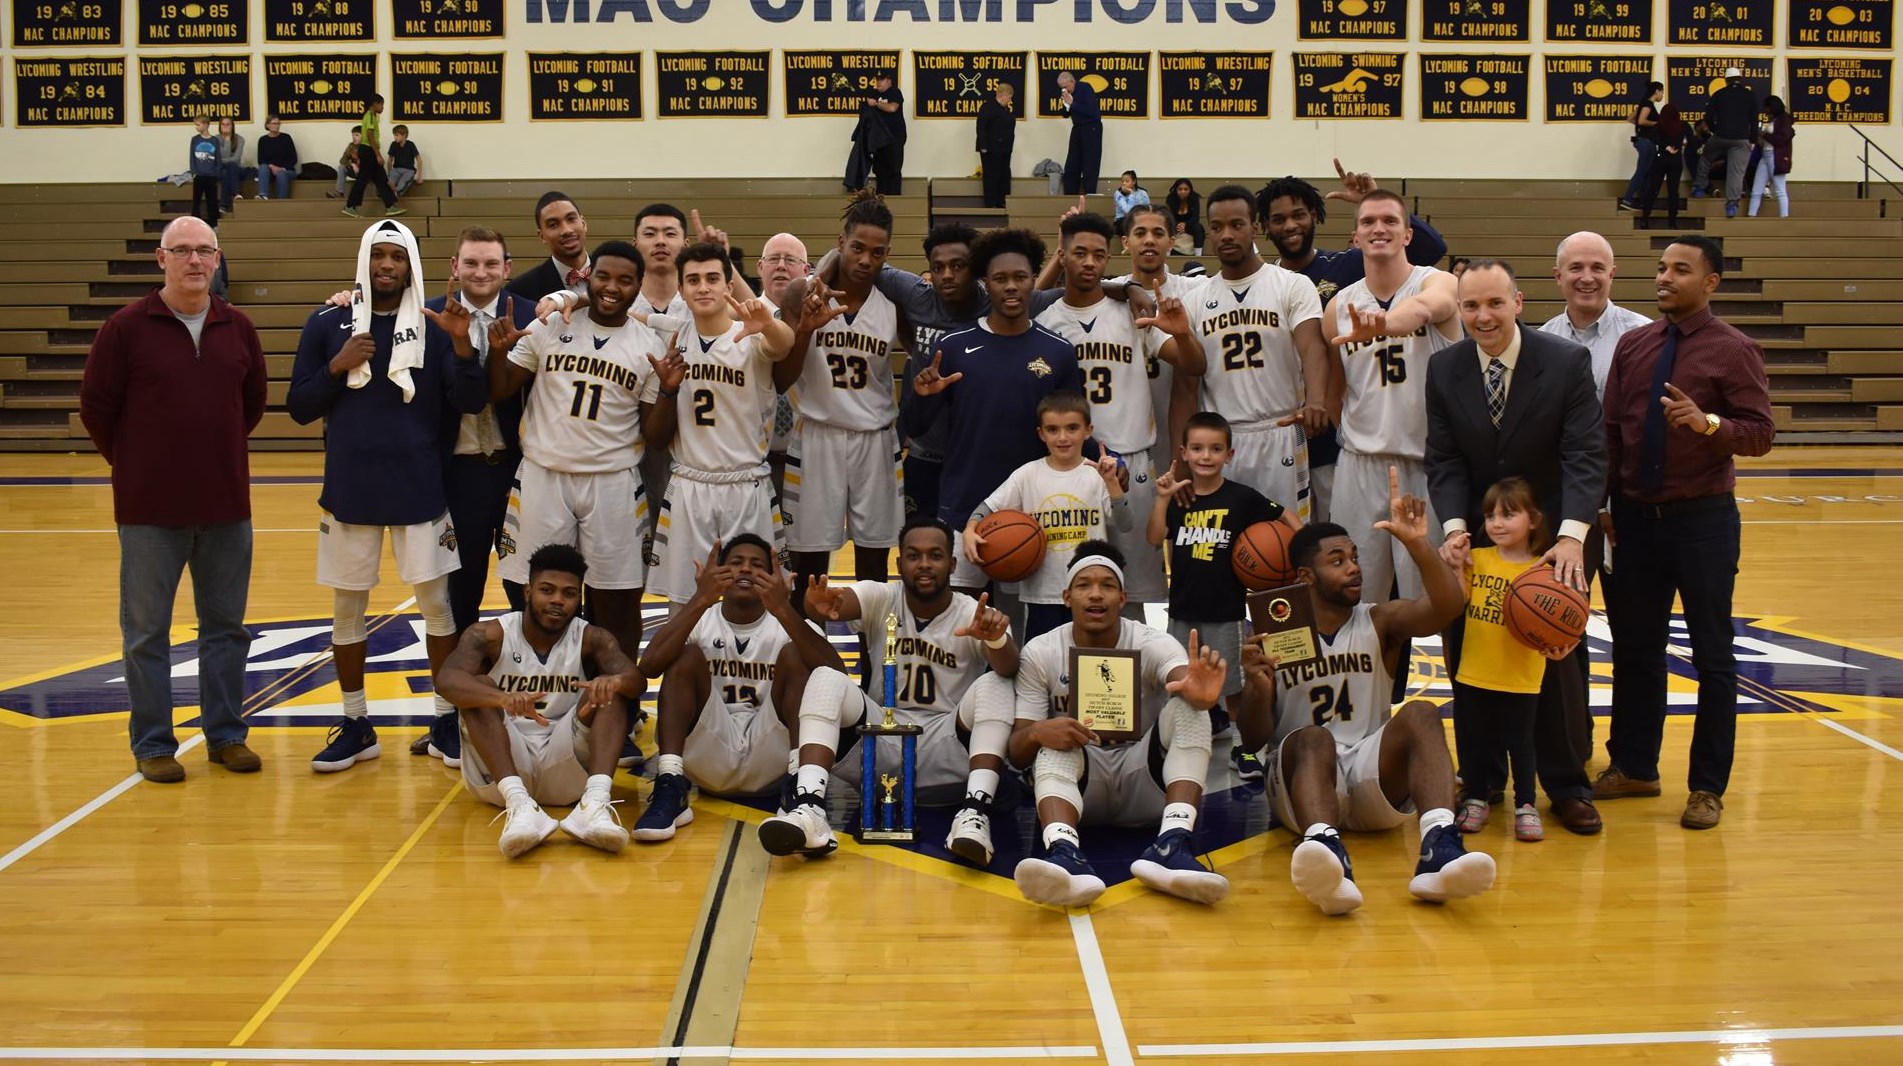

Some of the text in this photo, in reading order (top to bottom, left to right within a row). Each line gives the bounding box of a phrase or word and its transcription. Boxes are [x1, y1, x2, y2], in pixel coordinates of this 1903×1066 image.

[37, 6, 102, 18] 19 83
[162, 4, 228, 18] 19 85
[293, 2, 349, 15] 19 88
[421, 0, 478, 13] 19 90
[1323, 0, 1386, 13] 19 97
[1450, 2, 1505, 15] 19 98
[1574, 4, 1629, 17] 19 99
[1693, 6, 1748, 20] 20 01
[1809, 8, 1872, 22] 20 03
[149, 24, 236, 38] MAC CHAMPIONS
[276, 22, 363, 36] MAC CHAMPIONS
[405, 20, 491, 33] MAC CHAMPIONS
[1310, 20, 1396, 34] MAC CHAMPIONS
[1434, 22, 1518, 36] MAC CHAMPIONS
[1556, 24, 1641, 38] MAC CHAMPIONS
[24, 27, 110, 41] MAC CHAMPIONS
[1678, 27, 1763, 41] MAC CHAMPIONS
[1800, 29, 1881, 43] MAC CHAMPIONS
[140, 58, 250, 77] LYCOMING WRESTLING
[396, 61, 496, 74] LYCOMING FOOTBALL
[534, 60, 634, 74] LYCOMING FOOTBALL
[662, 58, 763, 71] LYCOMING FOOTBALL
[786, 53, 898, 71] LYCOMING WRESTLING
[919, 56, 1020, 69] LYCOMING SOFTBALL
[1042, 57, 1143, 71] LYCOMING FOOTBALL
[1160, 55, 1271, 72] LYCOMING WRESTLING
[1298, 52, 1398, 69] LYCOMING SWIMMING
[1425, 60, 1522, 74] LYCOMING FOOTBALL
[1546, 58, 1648, 75] LYCOMING FOOTBALL
[1696, 58, 1745, 68] LYCOMING
[1819, 60, 1861, 69] LYCOMING
[16, 62, 125, 78] LYCOMING WRESTLING
[269, 61, 370, 75] LYCOMING FOOTBALL
[1671, 67, 1770, 78] MEN'S BASTBALL
[1797, 68, 1883, 79] MEN'S BASKETBALL
[294, 80, 351, 94] 19 89
[558, 79, 613, 92] 19 91
[686, 77, 743, 90] 19 92
[811, 76, 877, 89] 19 94
[944, 78, 999, 91] 19 95
[1114, 77, 1127, 90] 96
[1189, 78, 1242, 90] 19 97
[1300, 73, 1400, 87] 19 97
[1445, 80, 1507, 94] 19 98
[41, 85, 105, 98] 19 84
[165, 82, 230, 96] 19 86
[420, 81, 478, 94] 19 90
[1573, 82, 1628, 95] 19 99
[1689, 85, 1705, 95] 20
[1808, 86, 1870, 95] 20 04
[542, 98, 629, 112] MAC CHAMPIONS
[670, 96, 757, 110] MAC CHAMPIONS
[798, 97, 818, 110] MAC
[1100, 98, 1137, 111] MPIONS
[1332, 93, 1365, 103] WOMEN'S
[153, 103, 240, 118] MAC CHAMPIONS
[279, 100, 365, 113] MAC CHAMPIONS
[404, 101, 491, 114] MAC CHAMPIONS
[927, 100, 947, 112] MAC
[1172, 99, 1257, 112] MAC CHAMPIONS
[1307, 103, 1390, 116] MAC CHAMPIONS
[1433, 100, 1516, 114] MAC CHAMPIONS
[1555, 104, 1575, 116] MAC
[28, 107, 113, 120] MAC CHAMPIONS
[1793, 112, 1884, 122] FREEDOM CHAMPIONS
[1202, 308, 1280, 337] LYCOMING
[1075, 342, 1133, 364] OMING
[1222, 331, 1264, 371] 22
[545, 354, 638, 391] LYCOMING
[826, 353, 868, 390] 23
[1374, 344, 1407, 387] 15
[684, 361, 745, 387] COMING
[570, 380, 603, 421] 11
[693, 388, 716, 427] 2
[1031, 509, 1100, 528] YCOMING
[1184, 508, 1229, 530] CAN'T
[1068, 531, 1087, 540] CAMP
[1175, 526, 1232, 546] HANDLE
[1192, 542, 1216, 561] ME
[1472, 574, 1511, 592] LYCOM
[1534, 593, 1561, 616] THE
[1281, 652, 1373, 690] LYCOMNG
[899, 663, 936, 705] 10
[1309, 679, 1354, 727] 24
